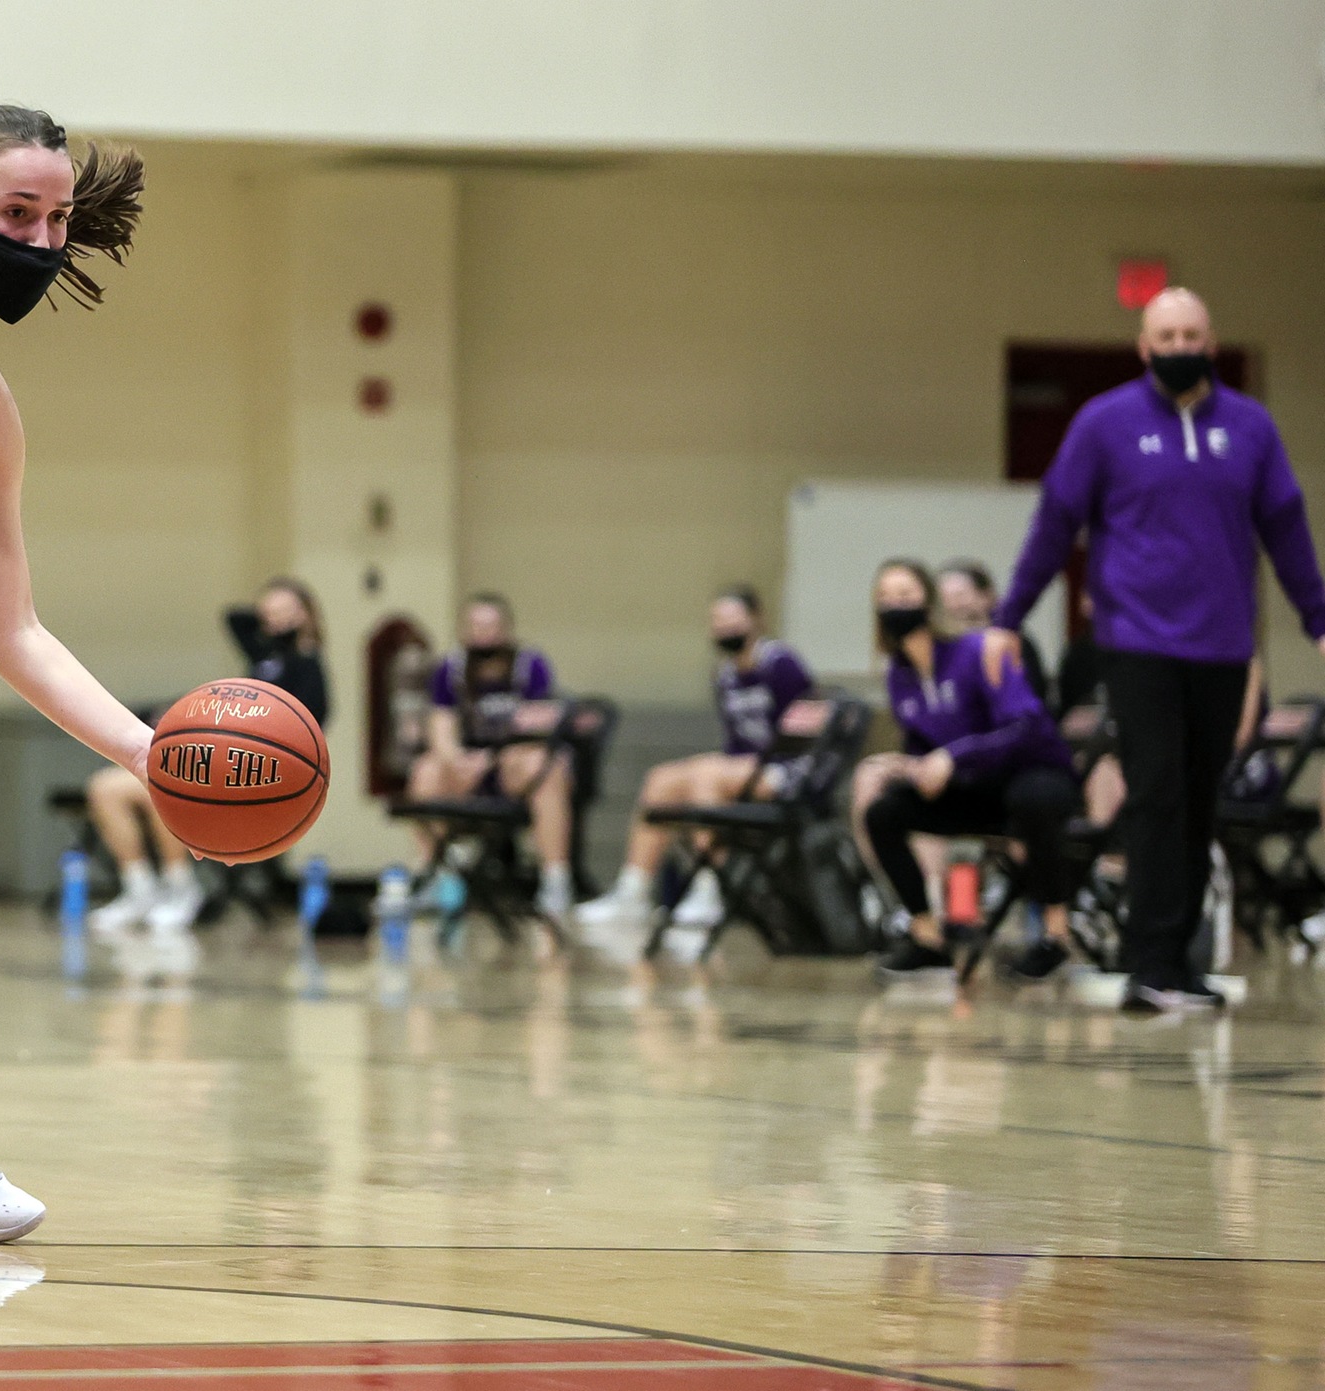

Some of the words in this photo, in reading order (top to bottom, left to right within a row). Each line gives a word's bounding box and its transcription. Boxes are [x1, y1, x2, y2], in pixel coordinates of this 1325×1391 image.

[208, 686, 259, 701] ROCK
[159, 743, 216, 786] ROCK
[224, 746, 283, 789] THE
